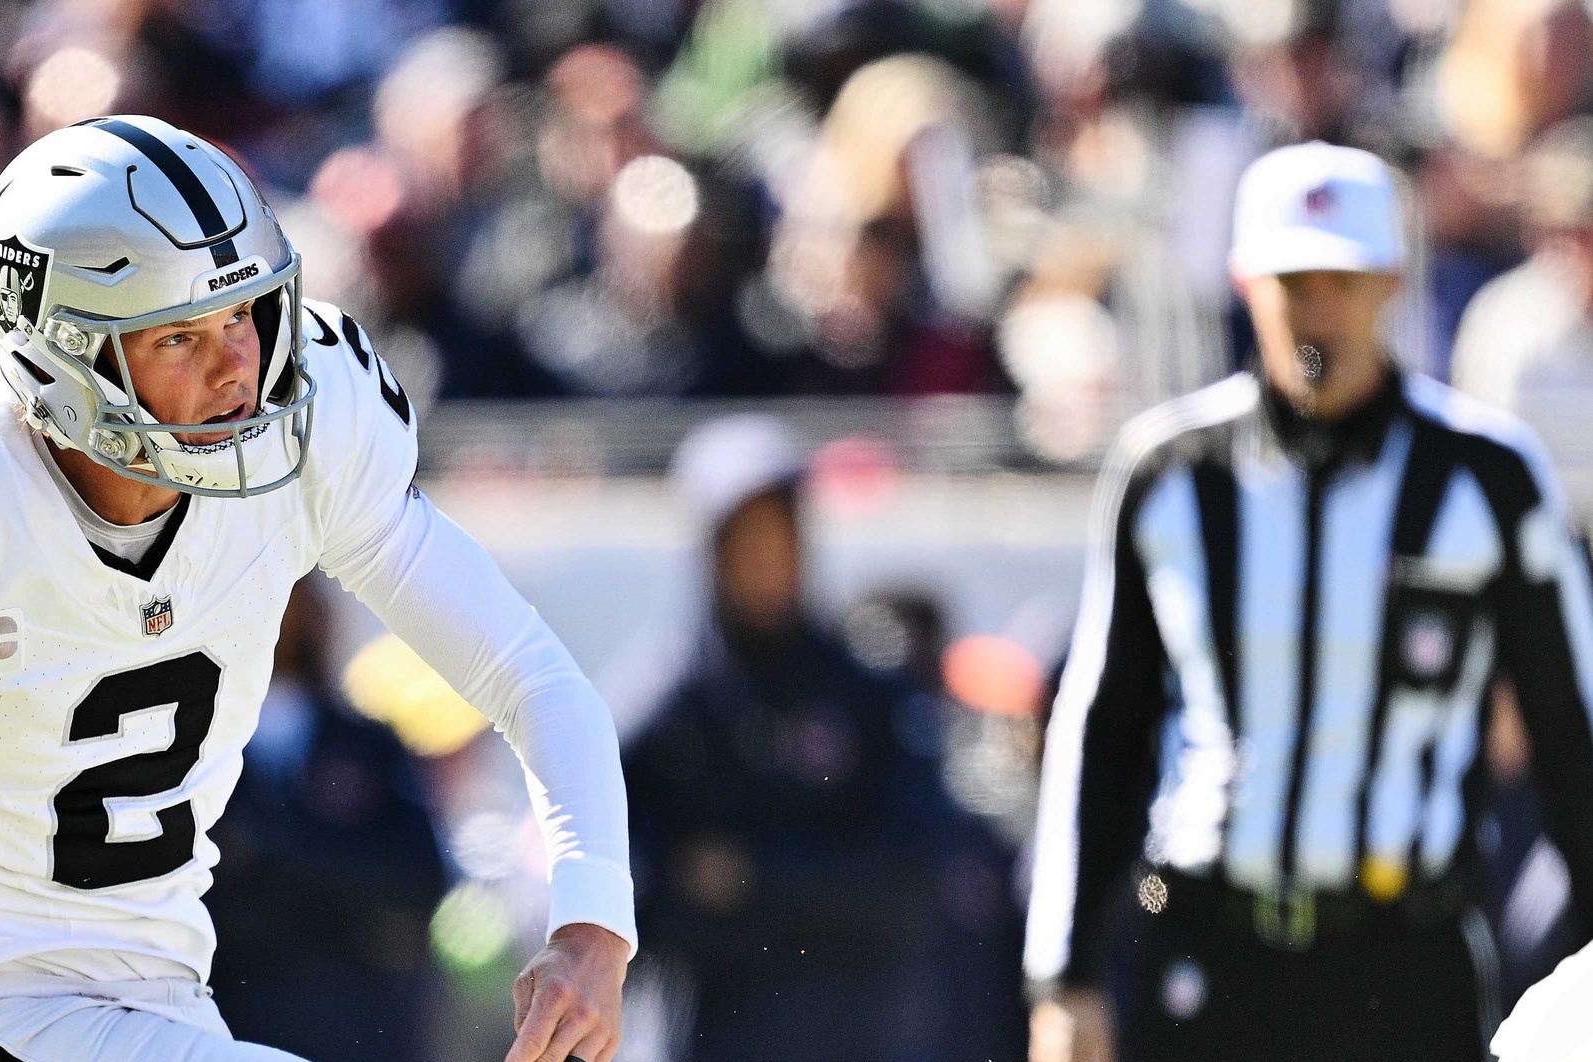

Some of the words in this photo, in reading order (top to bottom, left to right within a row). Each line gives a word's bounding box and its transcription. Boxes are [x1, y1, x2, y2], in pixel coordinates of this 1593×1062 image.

[208, 263, 259, 292] RAIDERS
[149, 614, 170, 632] NFL
[47, 645, 227, 890] 2
